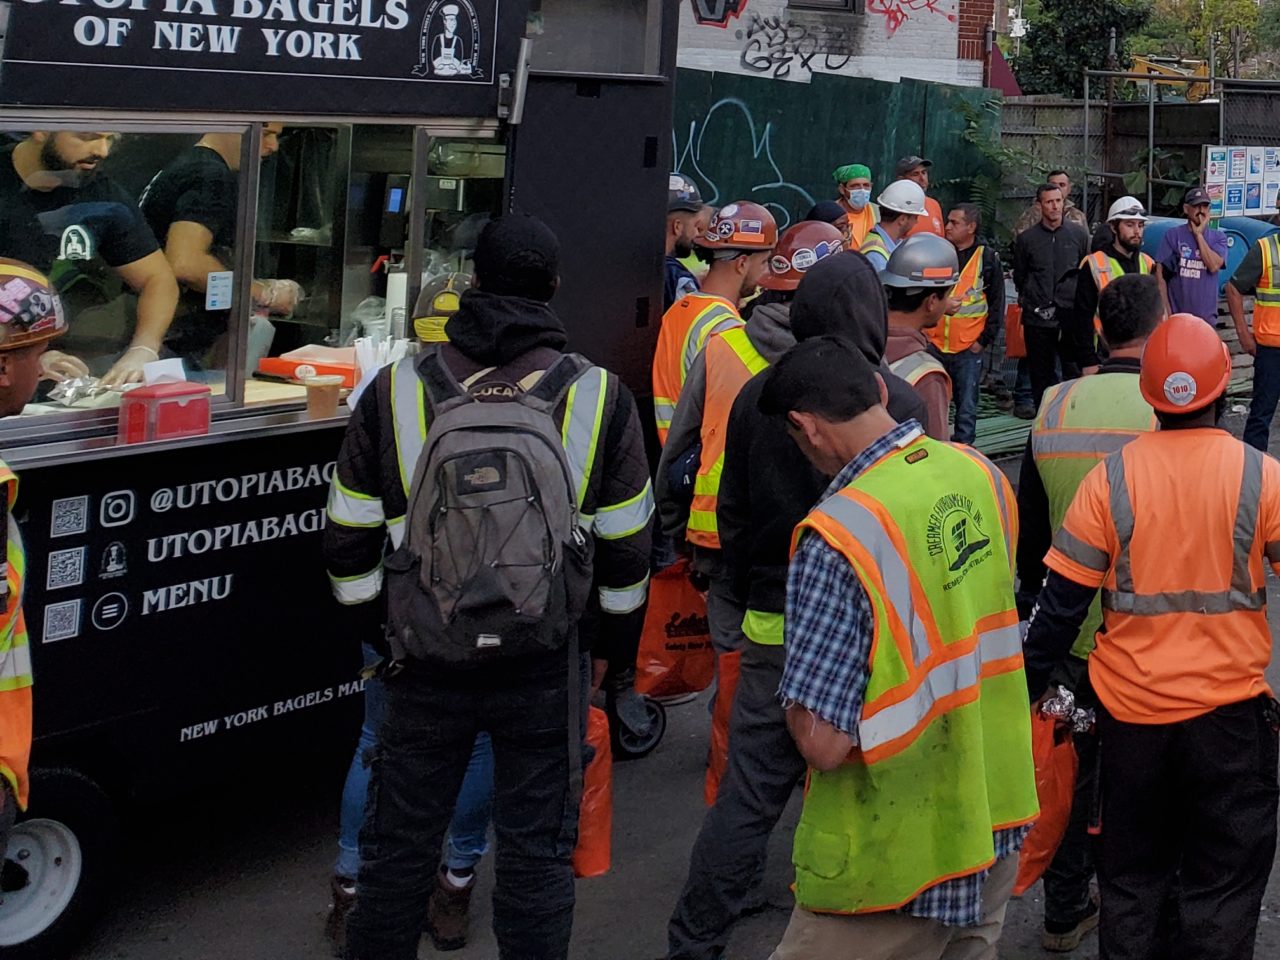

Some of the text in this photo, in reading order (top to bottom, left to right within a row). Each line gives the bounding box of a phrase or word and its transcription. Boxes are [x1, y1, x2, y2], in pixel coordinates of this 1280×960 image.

[74, 15, 362, 61] OF NEW YORK
[1172, 384, 1188, 394] 1010
[141, 574, 233, 615] MENU
[180, 719, 220, 742] NEW
[224, 705, 269, 729] YORK
[273, 688, 333, 716] BAGELS
